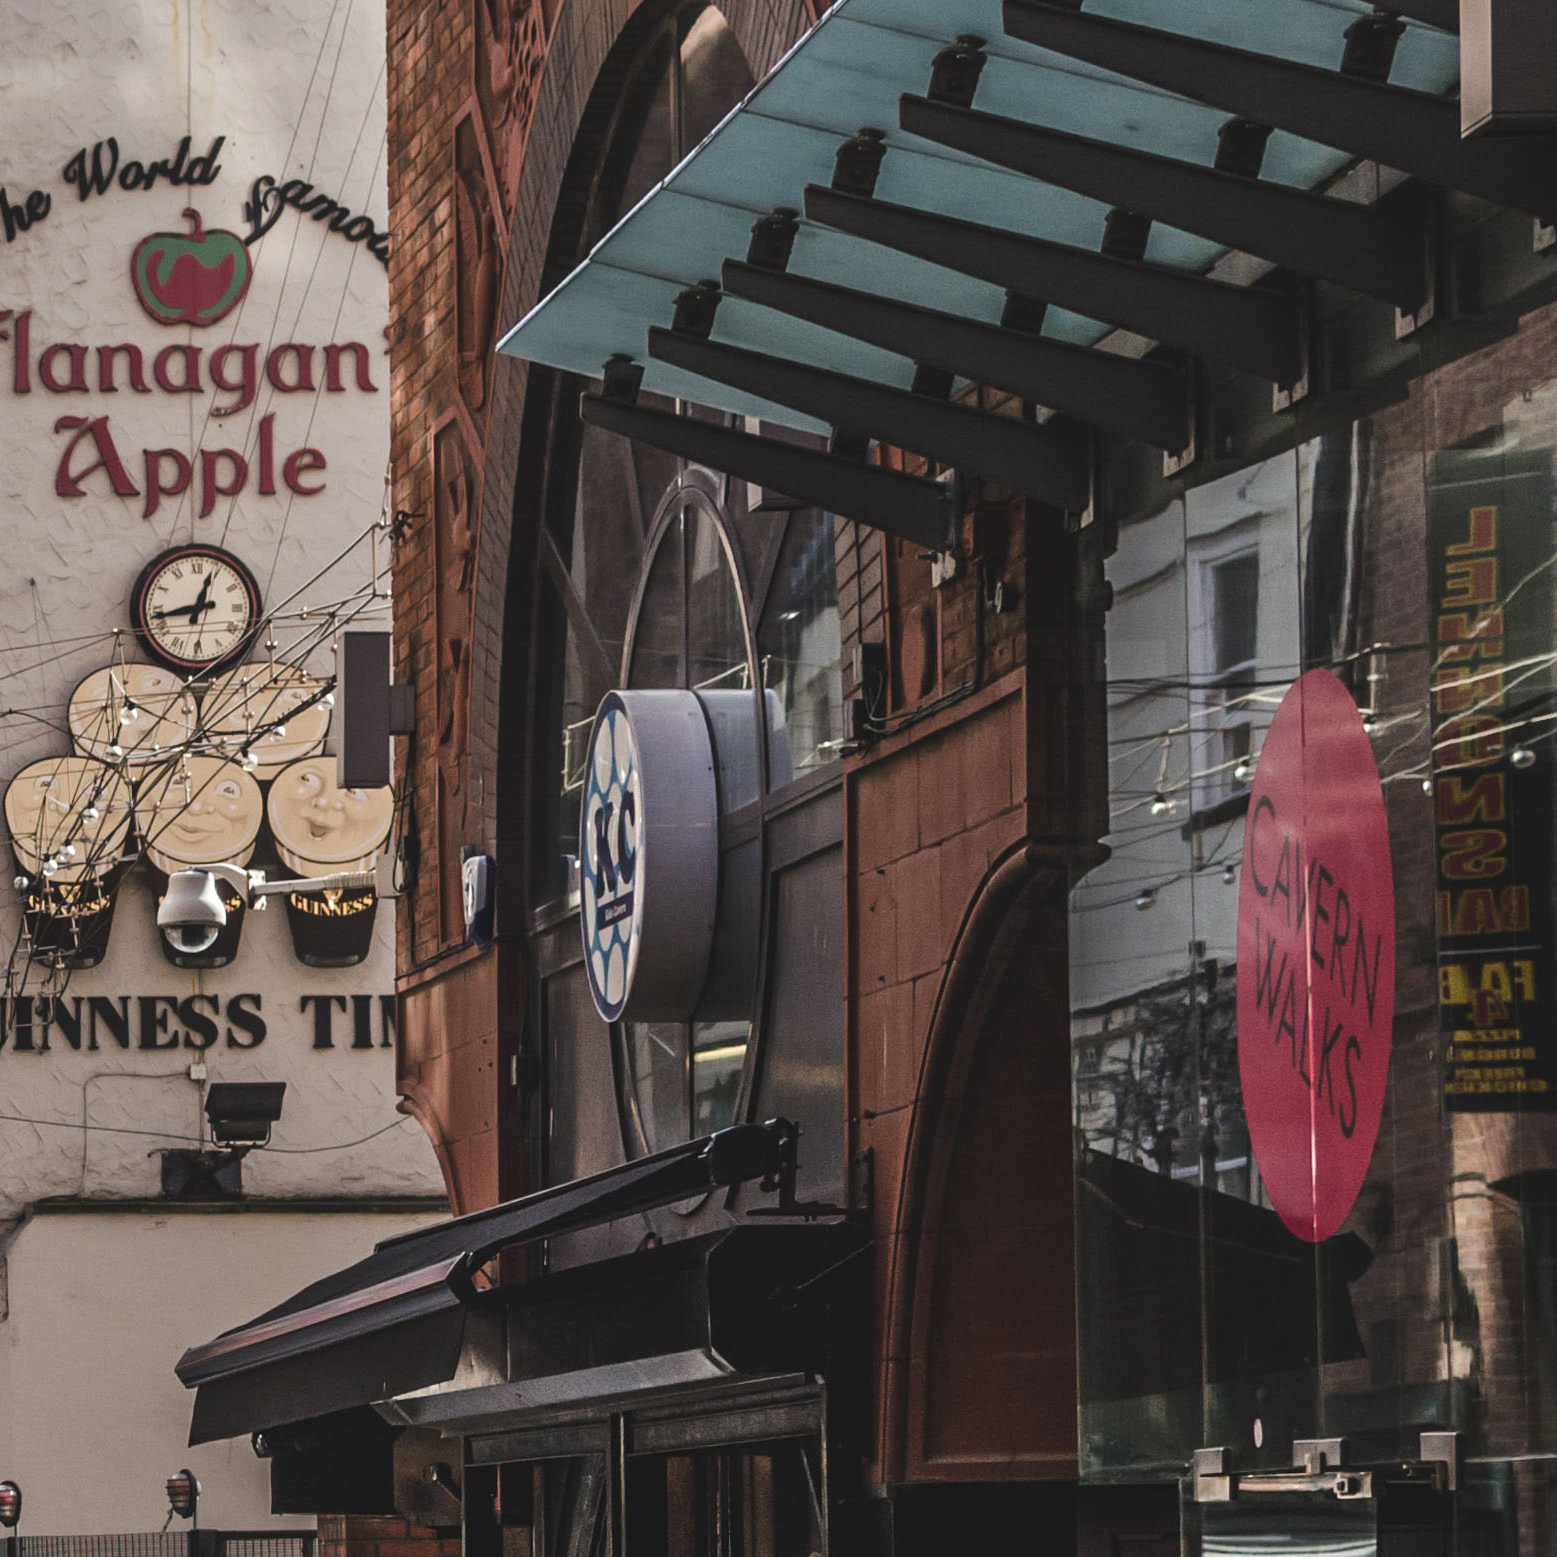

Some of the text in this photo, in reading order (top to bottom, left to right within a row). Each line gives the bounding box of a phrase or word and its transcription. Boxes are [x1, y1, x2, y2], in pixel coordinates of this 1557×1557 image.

[63, 135, 227, 202] World
[244, 174, 390, 272] famou
[53, 412, 327, 519] Apple
[291, 891, 374, 917] GUINNESS
[1250, 794, 1381, 1029] CAVERN
[301, 994, 396, 1049] TI
[1255, 916, 1360, 1139] WALKS
